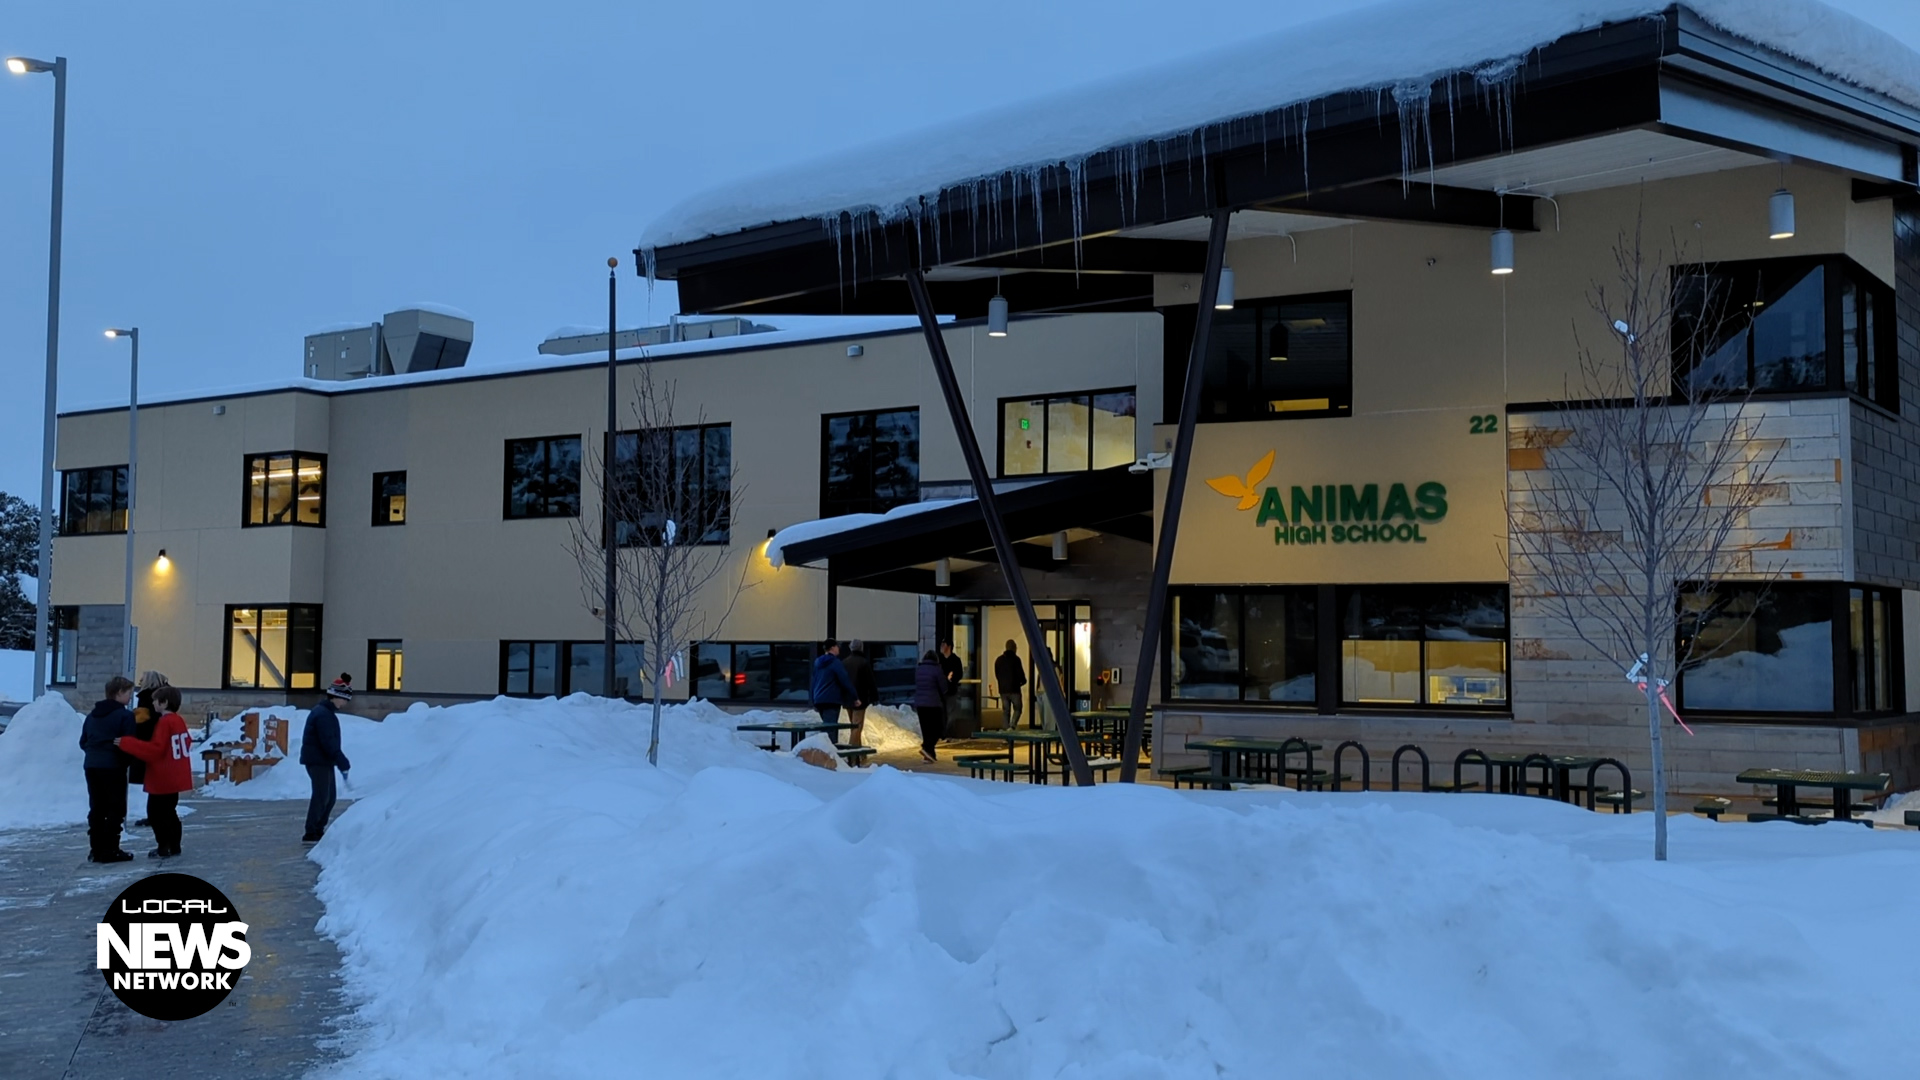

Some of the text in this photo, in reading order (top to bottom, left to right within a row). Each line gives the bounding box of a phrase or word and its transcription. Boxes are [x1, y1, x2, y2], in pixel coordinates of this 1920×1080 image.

[1469, 414, 1498, 434] 22
[1256, 481, 1448, 526] ANIMAS
[1274, 524, 1427, 545] HIGH SCHOOL
